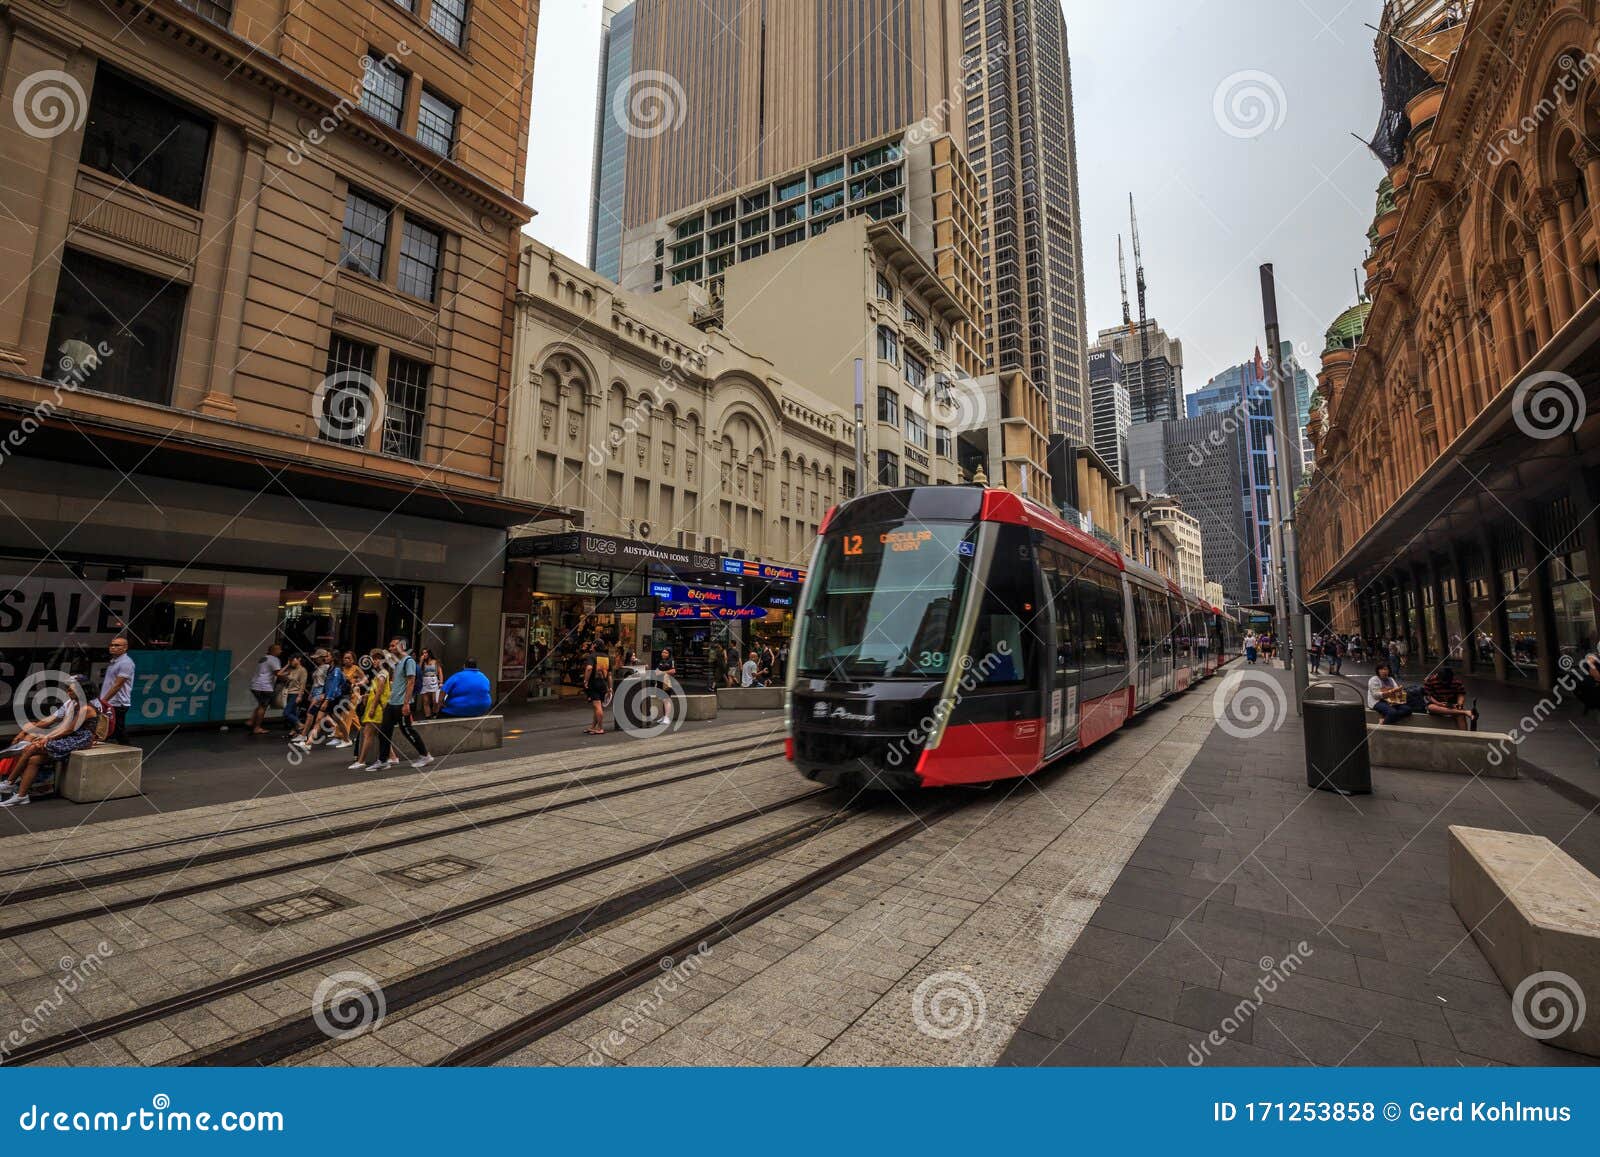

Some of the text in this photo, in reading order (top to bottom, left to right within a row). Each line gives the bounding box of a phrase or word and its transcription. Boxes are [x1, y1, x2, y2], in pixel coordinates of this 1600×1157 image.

[623, 545, 689, 563] AUSTRALIAN ICONS
[843, 534, 863, 556] L2
[0, 589, 126, 634] SALE
[919, 650, 945, 667] 39
[138, 672, 216, 695] 70%
[141, 694, 210, 719] OFF
